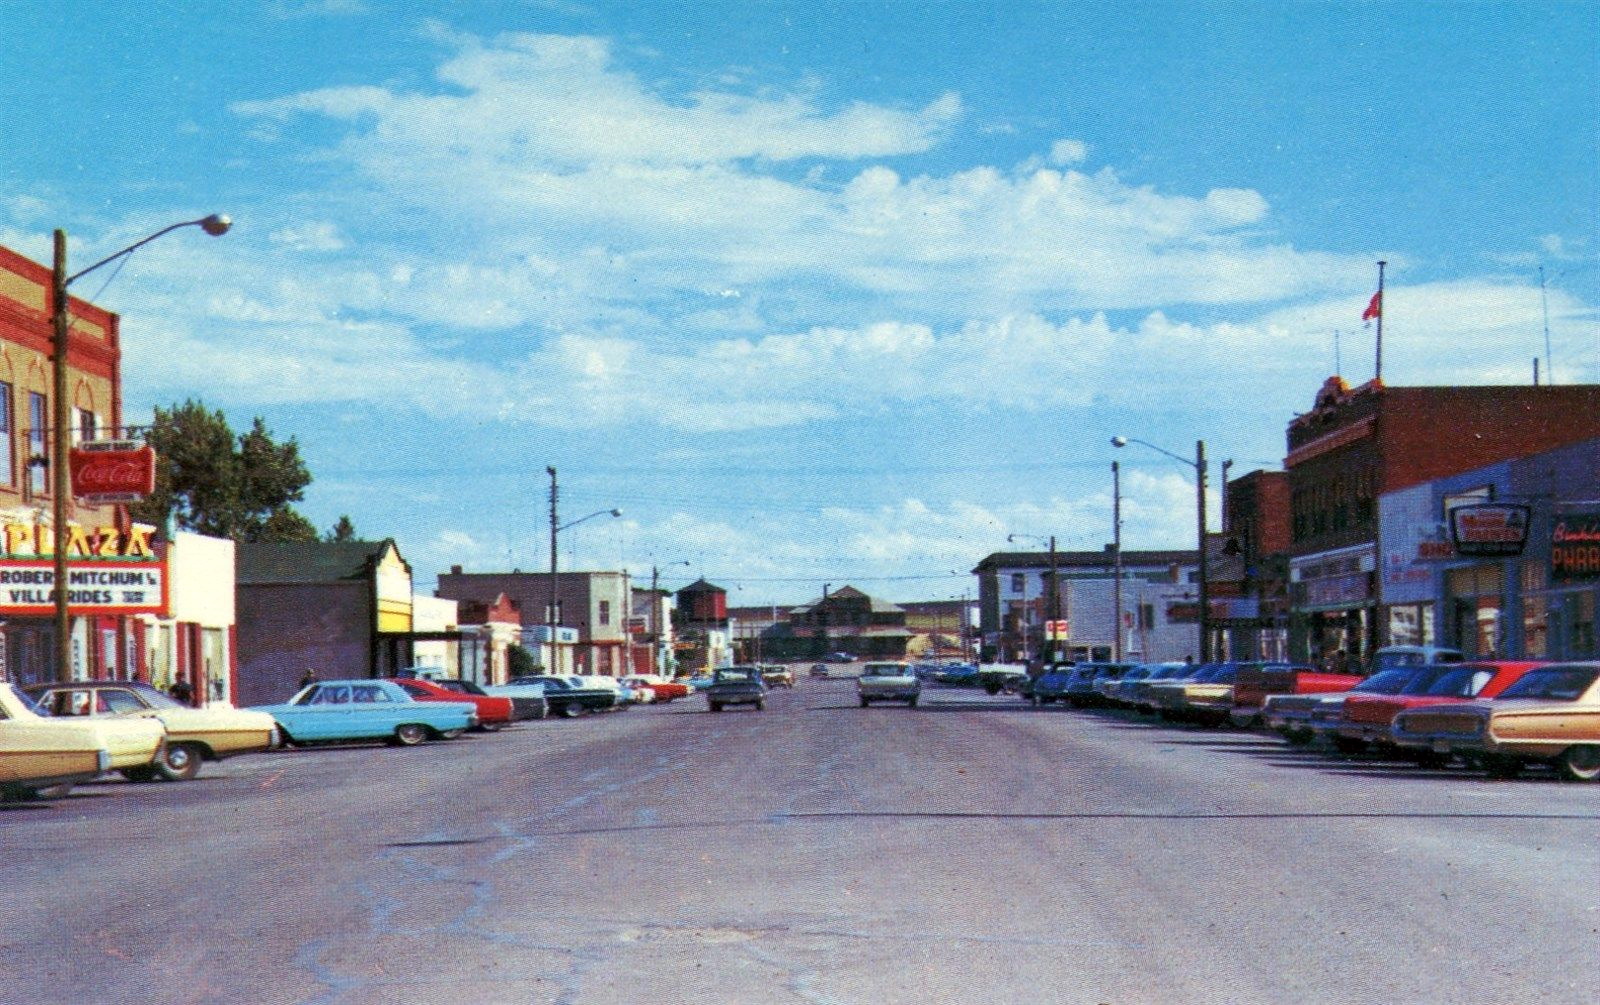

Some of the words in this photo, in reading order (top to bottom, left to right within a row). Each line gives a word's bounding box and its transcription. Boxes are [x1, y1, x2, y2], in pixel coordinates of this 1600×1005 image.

[6, 522, 156, 557] PLAZA
[0, 570, 58, 584] ROBER
[70, 571, 143, 585] MITCHUM
[67, 590, 112, 603] RIDES
